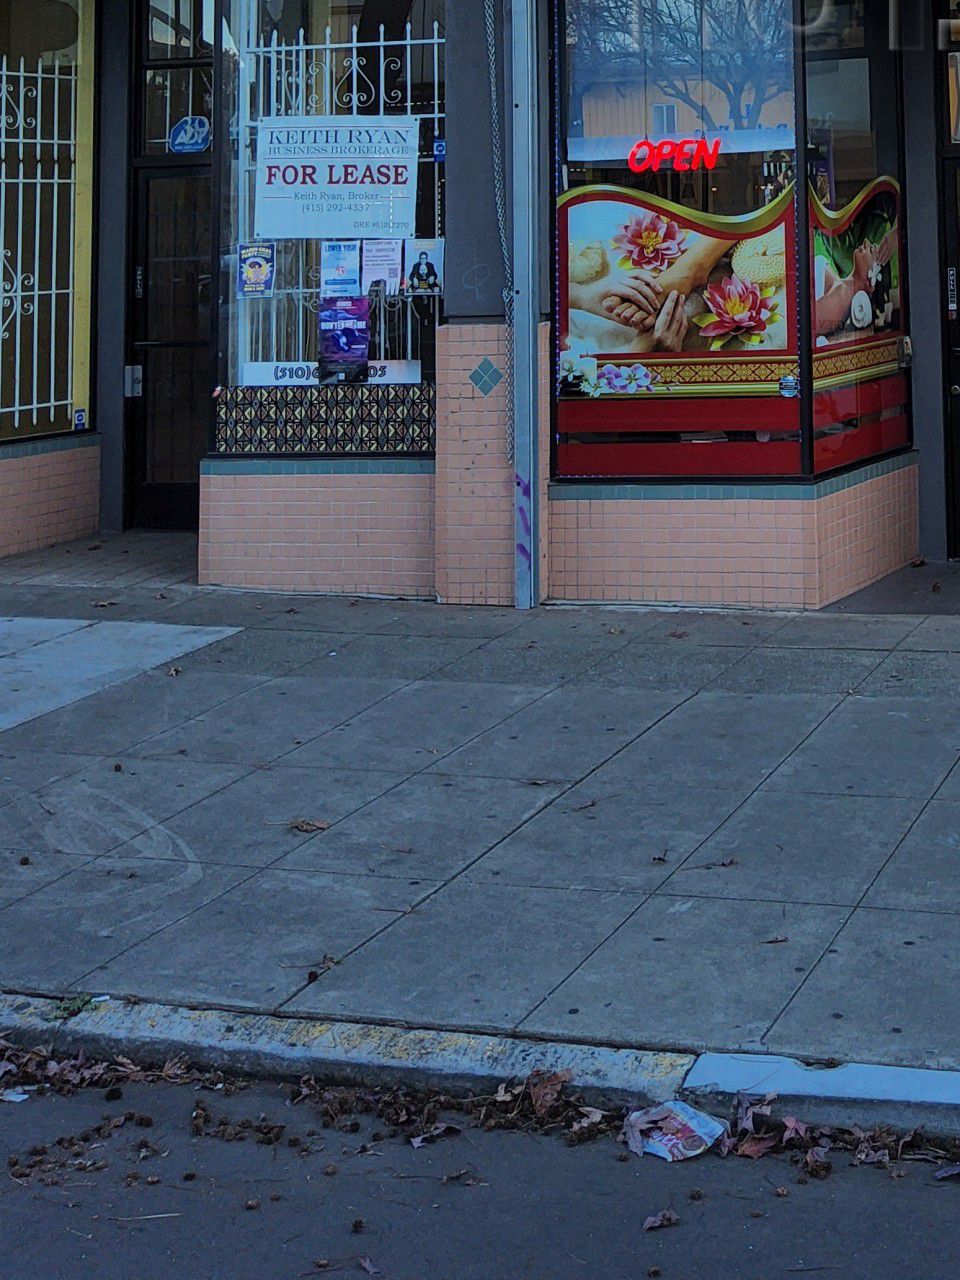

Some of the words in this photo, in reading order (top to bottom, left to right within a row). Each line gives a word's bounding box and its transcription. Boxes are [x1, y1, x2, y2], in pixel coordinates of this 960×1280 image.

[269, 130, 338, 145] KEITH
[348, 129, 410, 144] RYAN
[269, 146, 329, 155] BUSINESS
[331, 145, 409, 155] BROKERAGE
[628, 138, 721, 173] OPEN
[266, 165, 317, 185] FOR
[327, 165, 409, 185] LEASE
[293, 192, 318, 200] Keith
[320, 192, 345, 202] Ryan,
[348, 191, 379, 200] Broker
[302, 203, 324, 213] (415)
